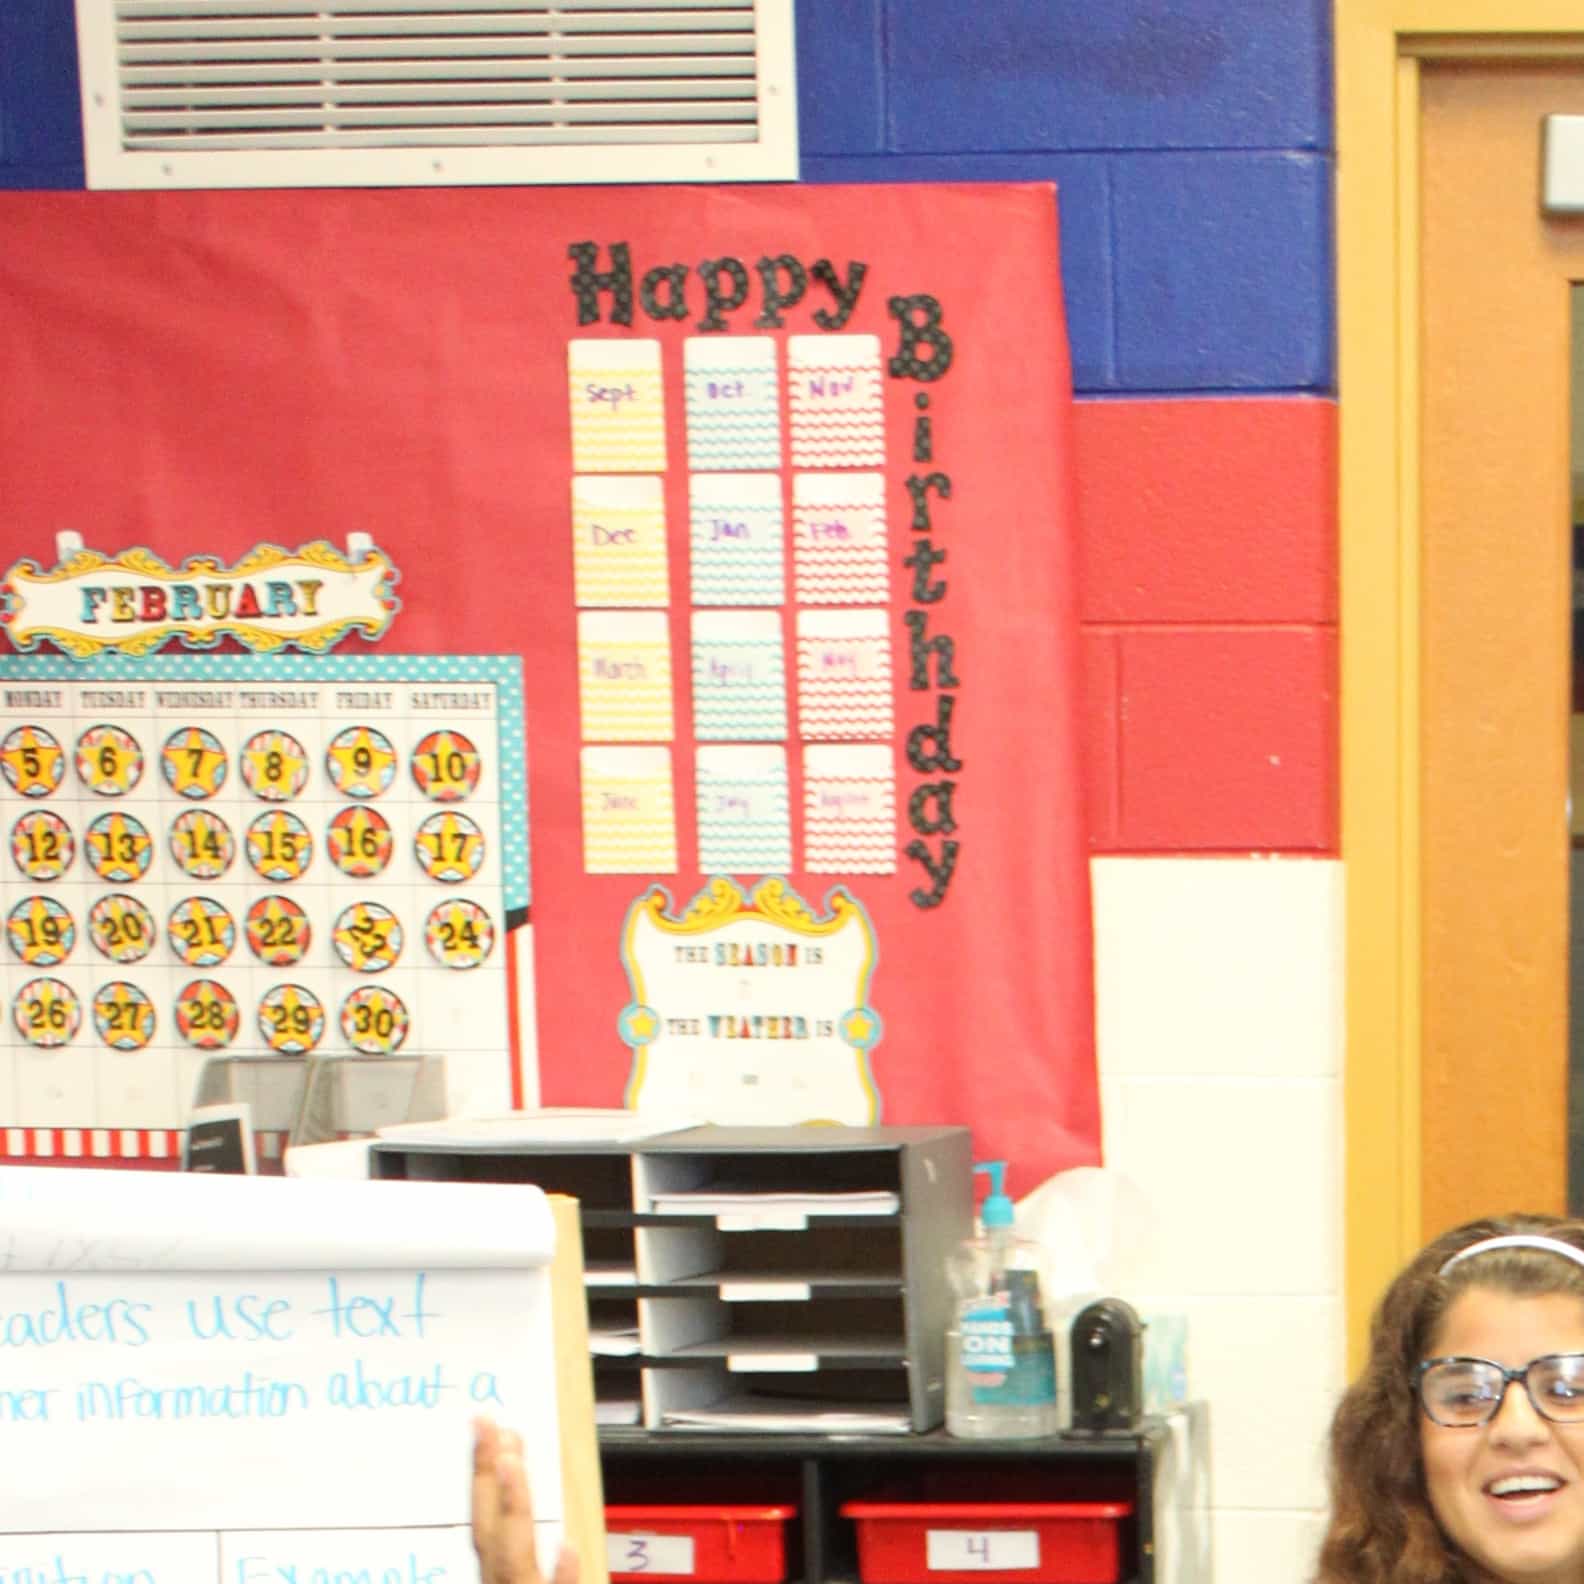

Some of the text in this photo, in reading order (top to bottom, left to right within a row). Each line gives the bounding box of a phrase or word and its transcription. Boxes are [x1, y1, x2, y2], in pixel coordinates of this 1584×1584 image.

[567, 241, 868, 332] Happy
[585, 383, 637, 411] Sept
[79, 579, 324, 625] FEBRUARY
[887, 294, 962, 909] Birthday
[23, 747, 467, 782] 5 6 7 8 9 10
[27, 827, 469, 864] 12 13 14 15 16 17
[25, 914, 479, 957] 19 20 21 22 23 24
[28, 998, 395, 1038] 26 27 28 29 30
[0, 1271, 444, 1347] aders use text
[77, 1371, 309, 1421] information
[328, 1359, 456, 1410] about
[470, 1371, 504, 1407] a
[966, 1535, 991, 1564] 4
